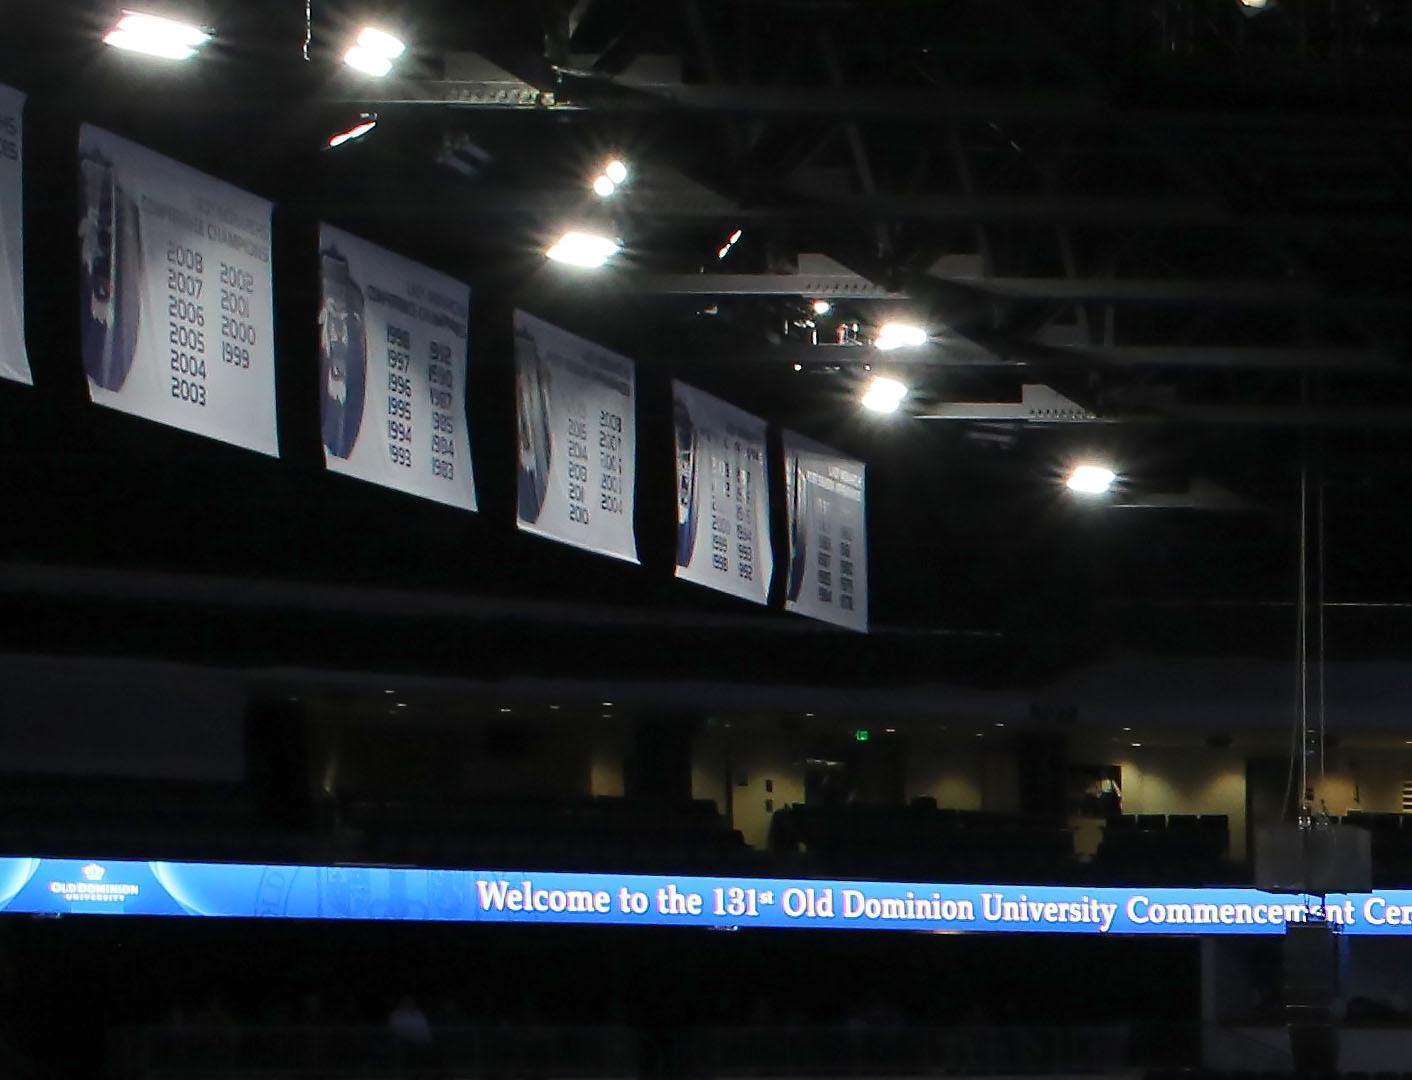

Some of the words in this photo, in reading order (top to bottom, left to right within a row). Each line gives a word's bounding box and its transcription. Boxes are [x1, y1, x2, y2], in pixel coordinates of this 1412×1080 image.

[167, 241, 203, 273] 2008
[168, 269, 203, 299] 2007
[220, 264, 254, 294] 2002
[169, 296, 204, 327] 2006
[221, 290, 250, 318] 2001
[169, 322, 205, 353] 2005
[221, 316, 256, 346] 2000
[171, 350, 207, 379] 2004
[222, 341, 250, 368] 1999
[172, 377, 206, 406] 2003
[50, 881, 77, 895] OLD
[77, 882, 139, 896] DOMINION
[476, 880, 611, 913] Welcome
[619, 888, 649, 914] to
[656, 884, 702, 916] the
[712, 886, 775, 917] 131st
[783, 887, 834, 919] Old
[843, 890, 976, 921] Dominion
[982, 893, 1117, 932] University
